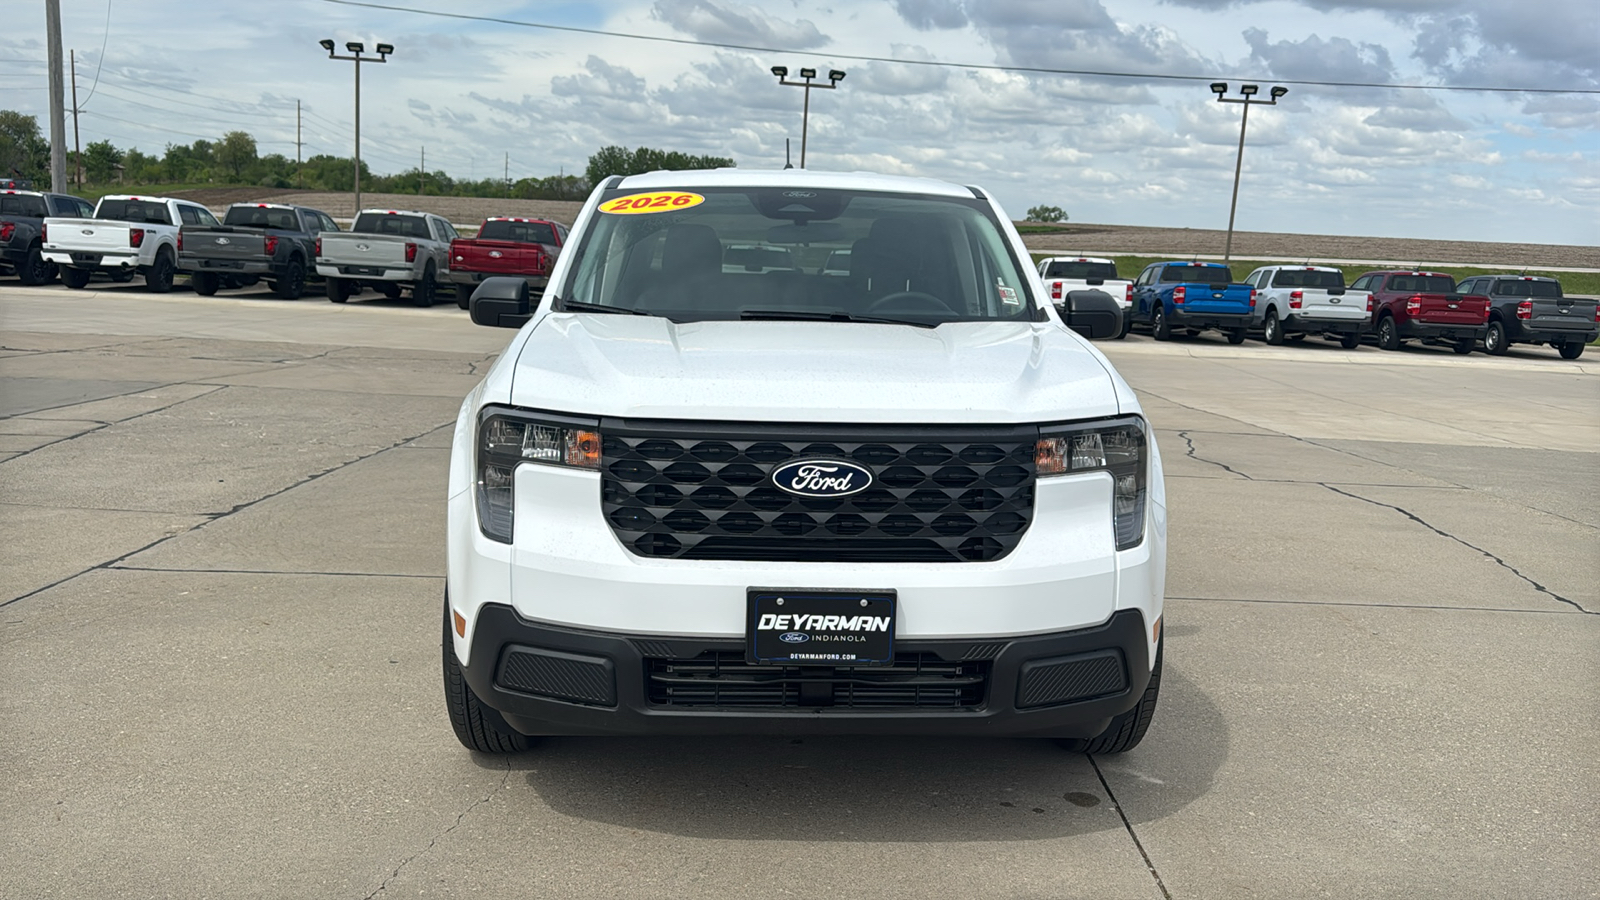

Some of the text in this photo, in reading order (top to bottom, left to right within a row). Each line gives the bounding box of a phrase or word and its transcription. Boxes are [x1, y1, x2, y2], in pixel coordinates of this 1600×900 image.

[609, 195, 693, 211] 2026
[791, 465, 854, 491] Ford
[757, 614, 890, 631] DEYARMAN
[785, 633, 803, 641] Ford
